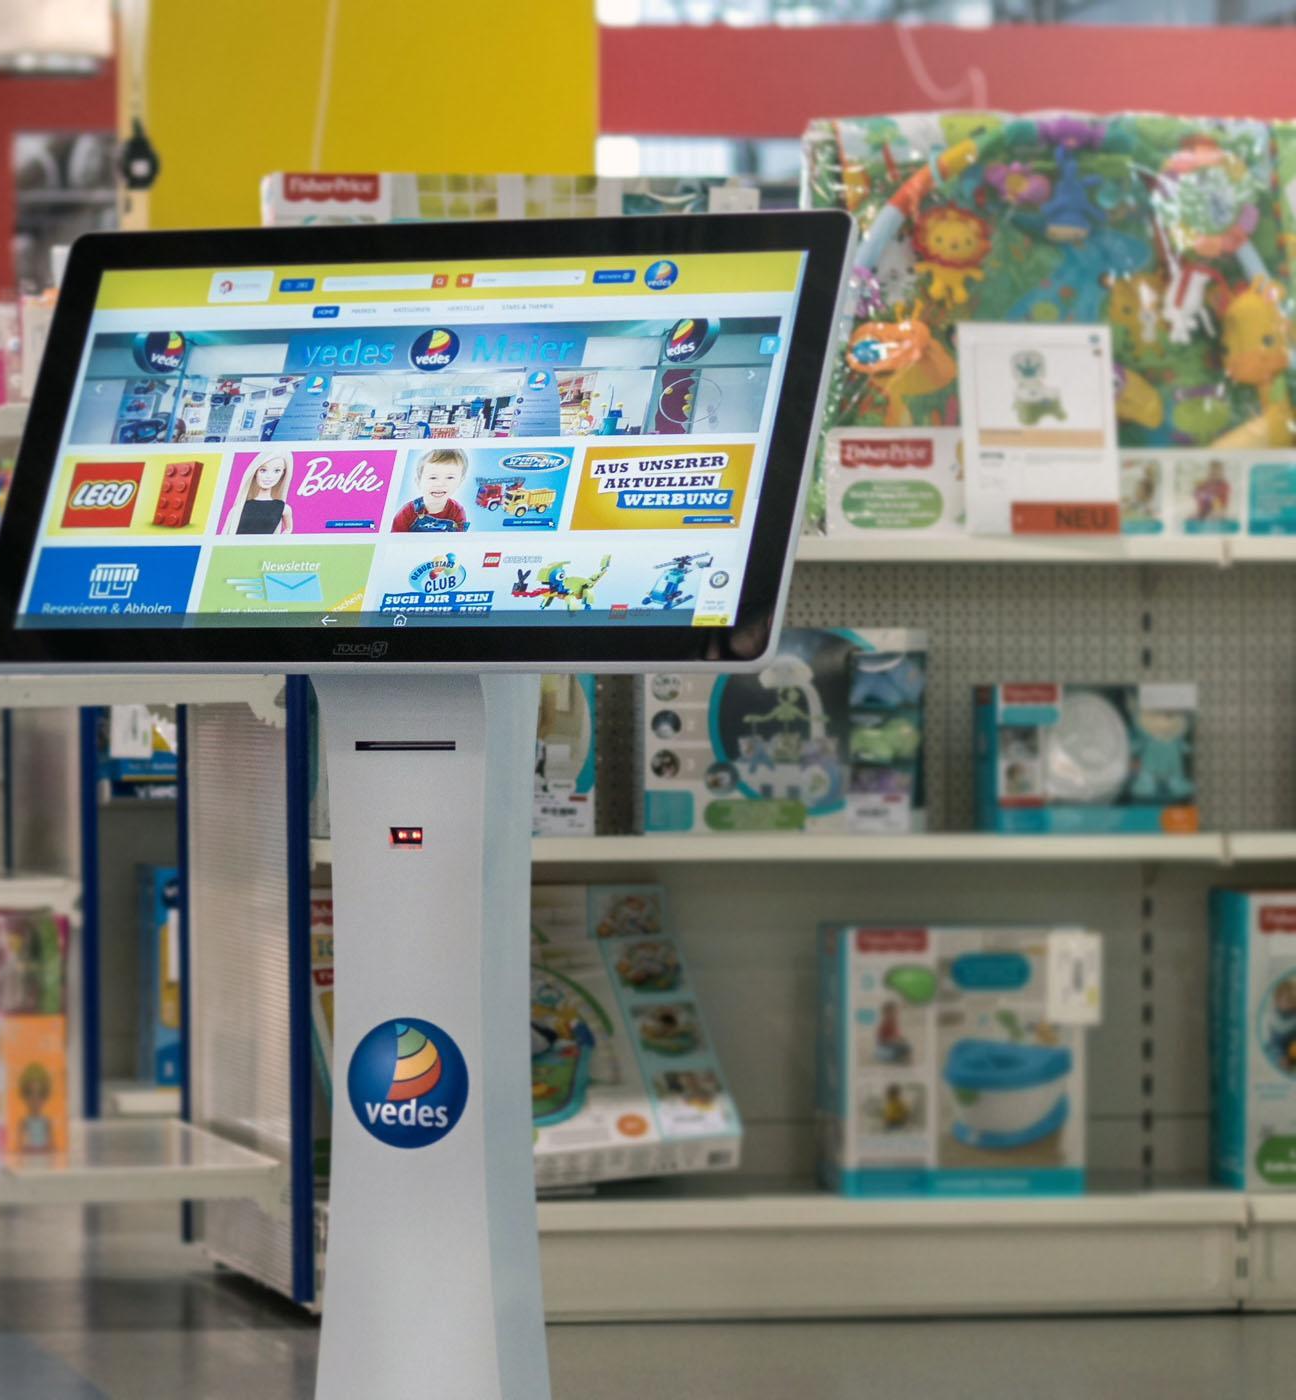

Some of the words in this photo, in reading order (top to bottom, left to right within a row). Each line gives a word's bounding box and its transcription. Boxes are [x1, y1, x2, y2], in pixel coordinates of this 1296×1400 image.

[304, 337, 396, 368] vedes
[471, 334, 575, 362] Maier
[415, 353, 451, 366] vedes
[594, 462, 629, 476] AUS
[639, 456, 725, 472] UNSERER
[296, 456, 384, 497] Barbie
[604, 475, 716, 489] AKTUELLEN
[71, 482, 136, 507] LEGO
[622, 492, 728, 506] WERBUNG
[1055, 507, 1111, 529] NEU
[261, 560, 321, 572] Newsletter
[424, 575, 457, 593] CLUB
[384, 595, 420, 605] SUCH
[424, 594, 450, 604] DIR
[455, 593, 490, 603] DEIN
[41, 602, 107, 615] Reservieren
[110, 602, 120, 614] &
[124, 602, 172, 614] Abholen
[365, 1098, 449, 1129] vedes
